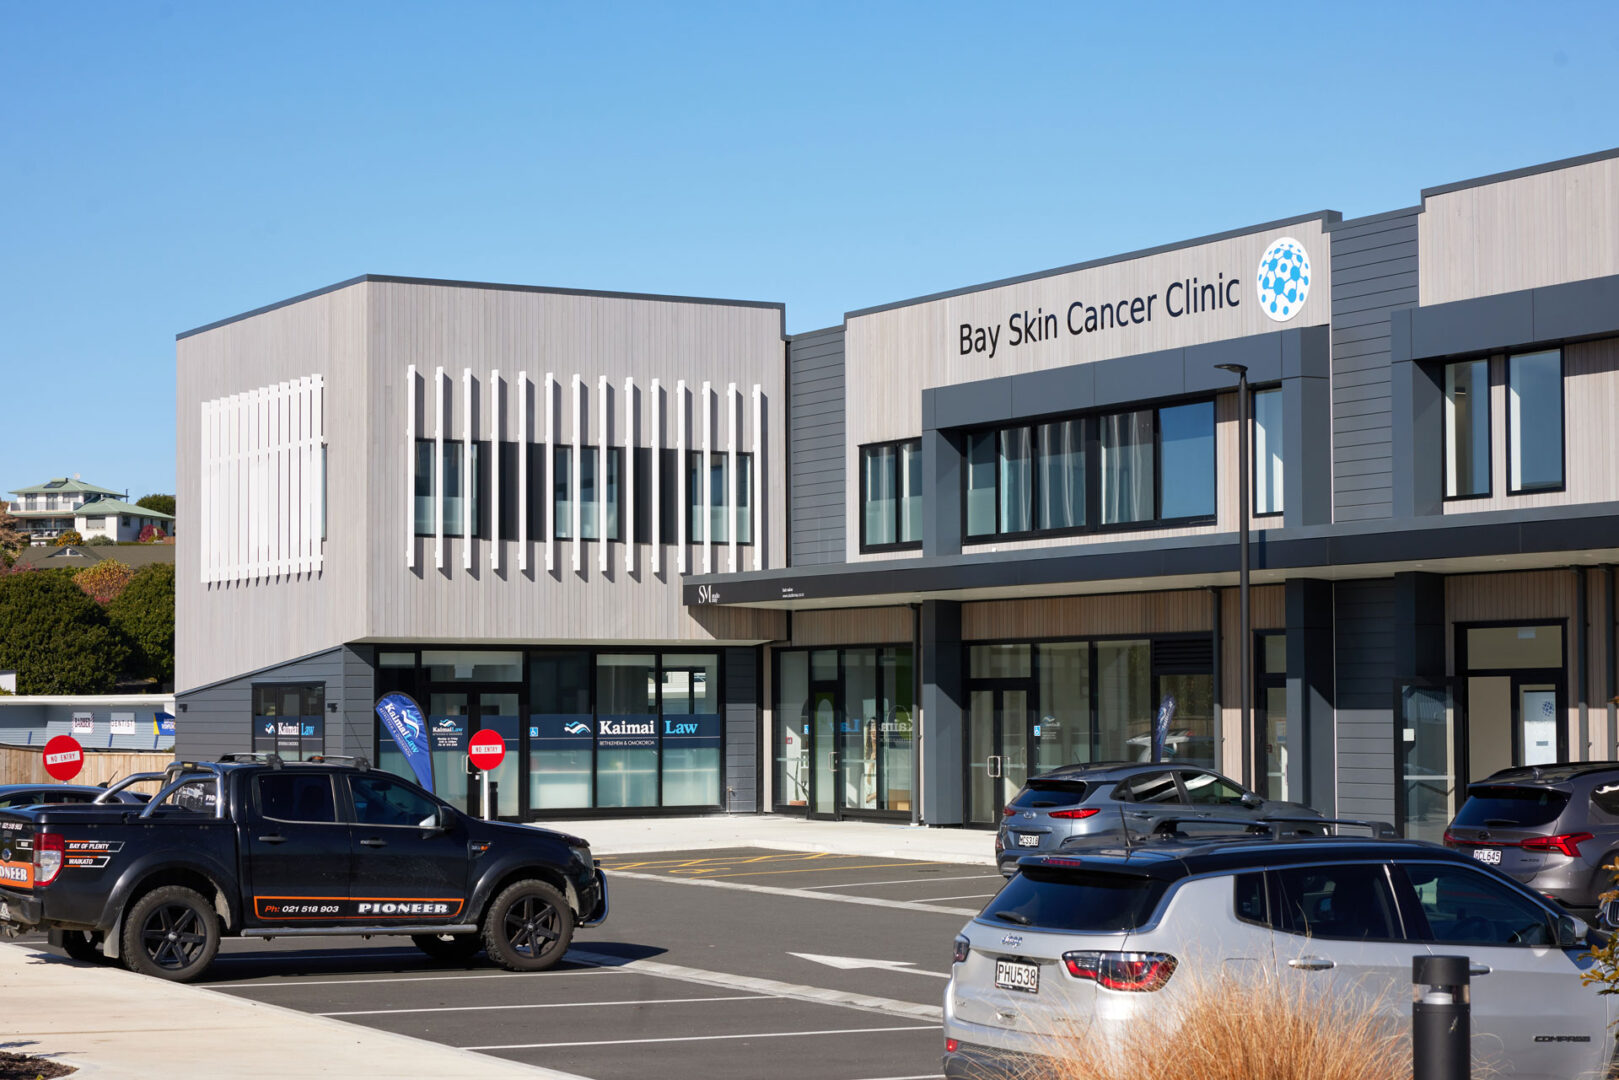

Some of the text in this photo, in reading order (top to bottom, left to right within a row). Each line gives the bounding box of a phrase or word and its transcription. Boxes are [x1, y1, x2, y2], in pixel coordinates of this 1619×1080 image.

[959, 272, 1240, 358] Bay Skin Cancer Clinic
[111, 719, 134, 728] DENTIST
[278, 722, 315, 736] Kaimai Law
[599, 720, 698, 735] Kaimai Law
[60, 753, 76, 761] ENTRY
[0, 866, 27, 881] ONEER
[265, 905, 339, 913] Ph: 021 518 903
[358, 903, 449, 914] PIONEER
[1001, 935, 1023, 948] Jeep
[997, 964, 1036, 986] PHU538
